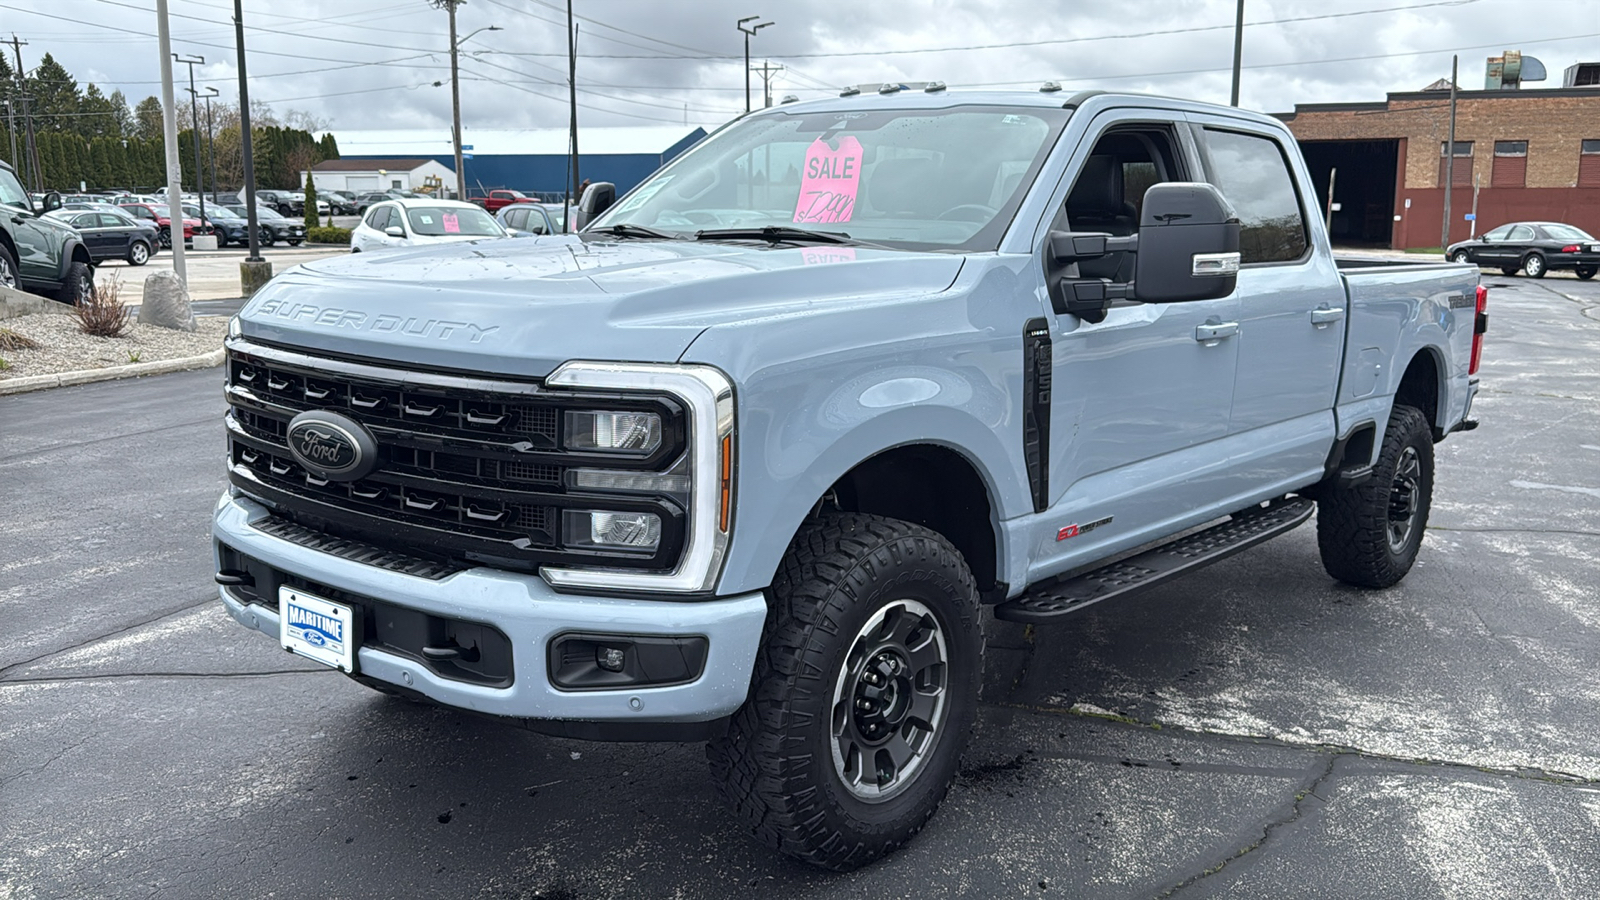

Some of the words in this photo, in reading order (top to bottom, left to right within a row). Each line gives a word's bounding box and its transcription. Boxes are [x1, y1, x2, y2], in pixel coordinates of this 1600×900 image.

[807, 157, 855, 179] SALE
[258, 299, 368, 330] SUPER
[370, 314, 500, 343] DUTY
[301, 429, 341, 462] Ford
[289, 605, 342, 641] MARITIME
